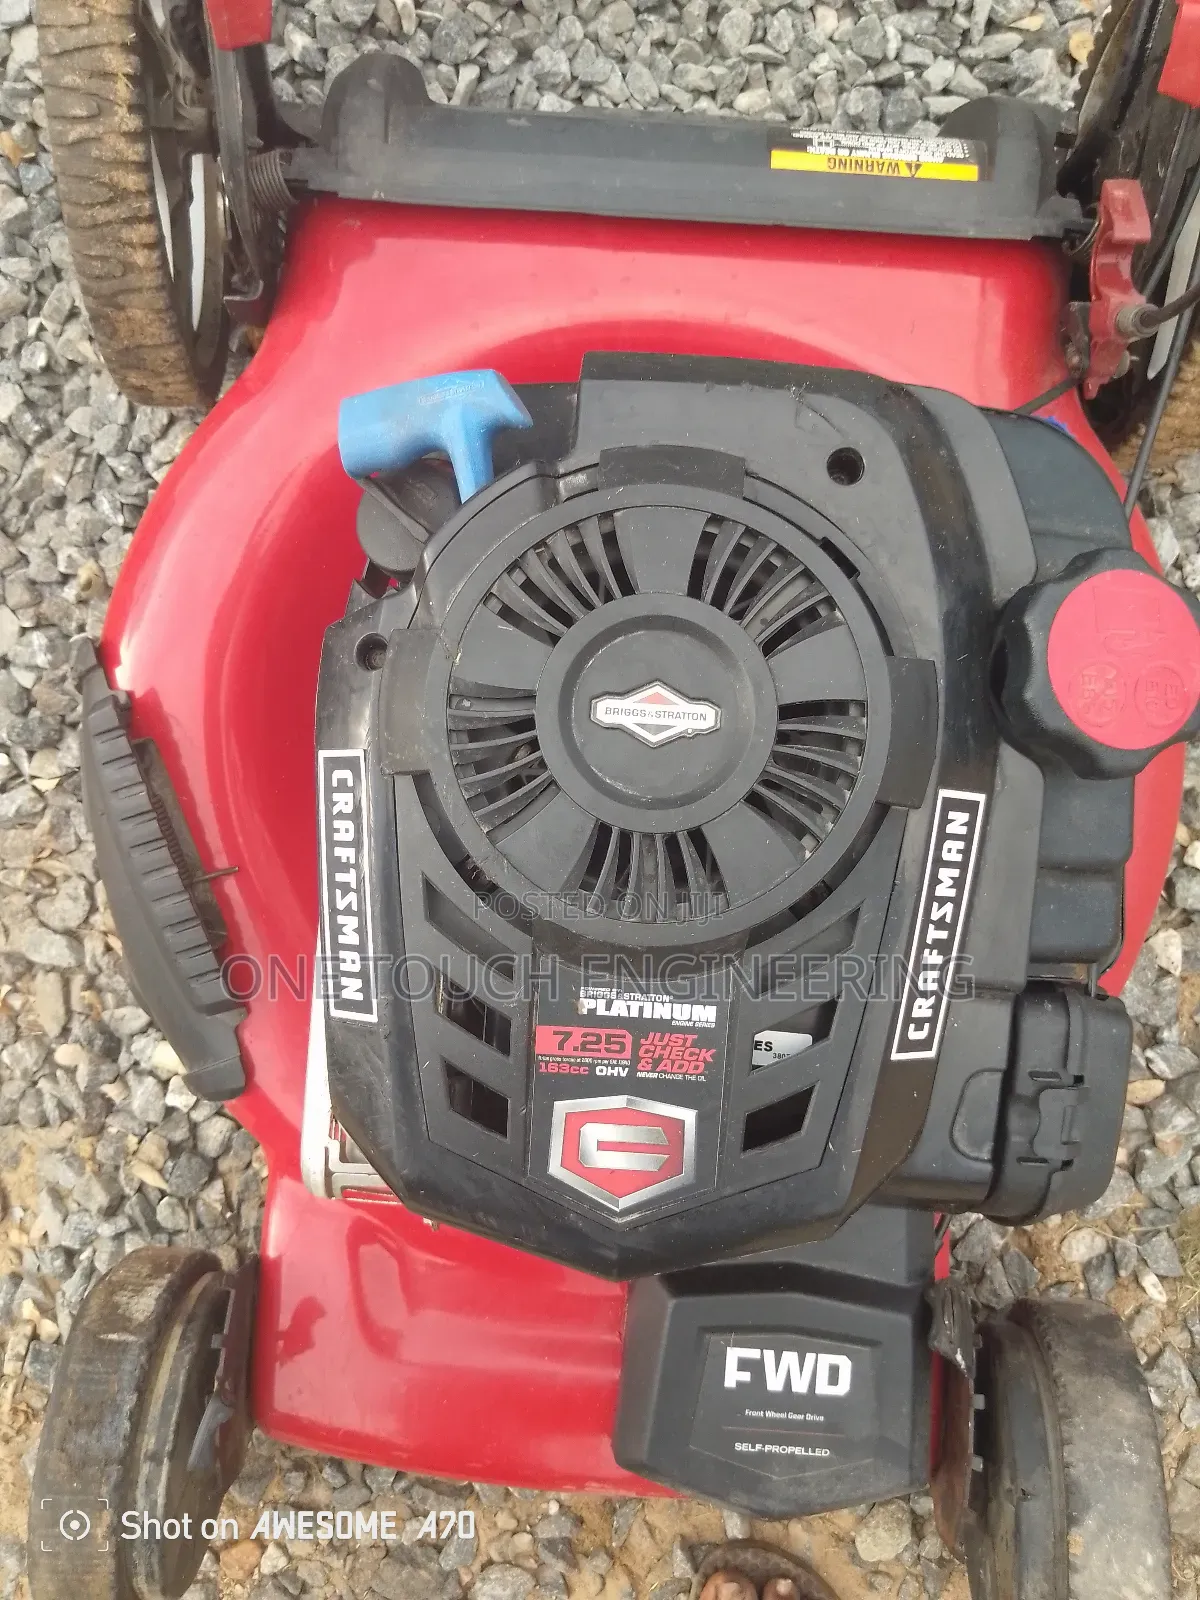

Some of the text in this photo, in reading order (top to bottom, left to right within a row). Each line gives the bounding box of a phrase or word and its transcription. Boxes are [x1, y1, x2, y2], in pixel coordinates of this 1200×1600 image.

[827, 156, 900, 175] WARNING
[331, 769, 364, 1000] CRAFTSMAN
[907, 811, 970, 1040] CRAFTSMAN
[579, 998, 717, 1022] PLATINUM
[552, 1030, 627, 1054] 7.25
[640, 1032, 698, 1047] JUST
[638, 1045, 717, 1062] CHECK
[539, 1062, 629, 1077] 163cc OHV
[636, 1058, 653, 1071] &
[656, 1060, 705, 1075] ADD
[636, 1071, 659, 1079] NEVER
[724, 1346, 852, 1396] FWD
[744, 1408, 825, 1422] Front Wheel Gear Drive
[734, 1442, 830, 1457] SELF-PROPELLED
